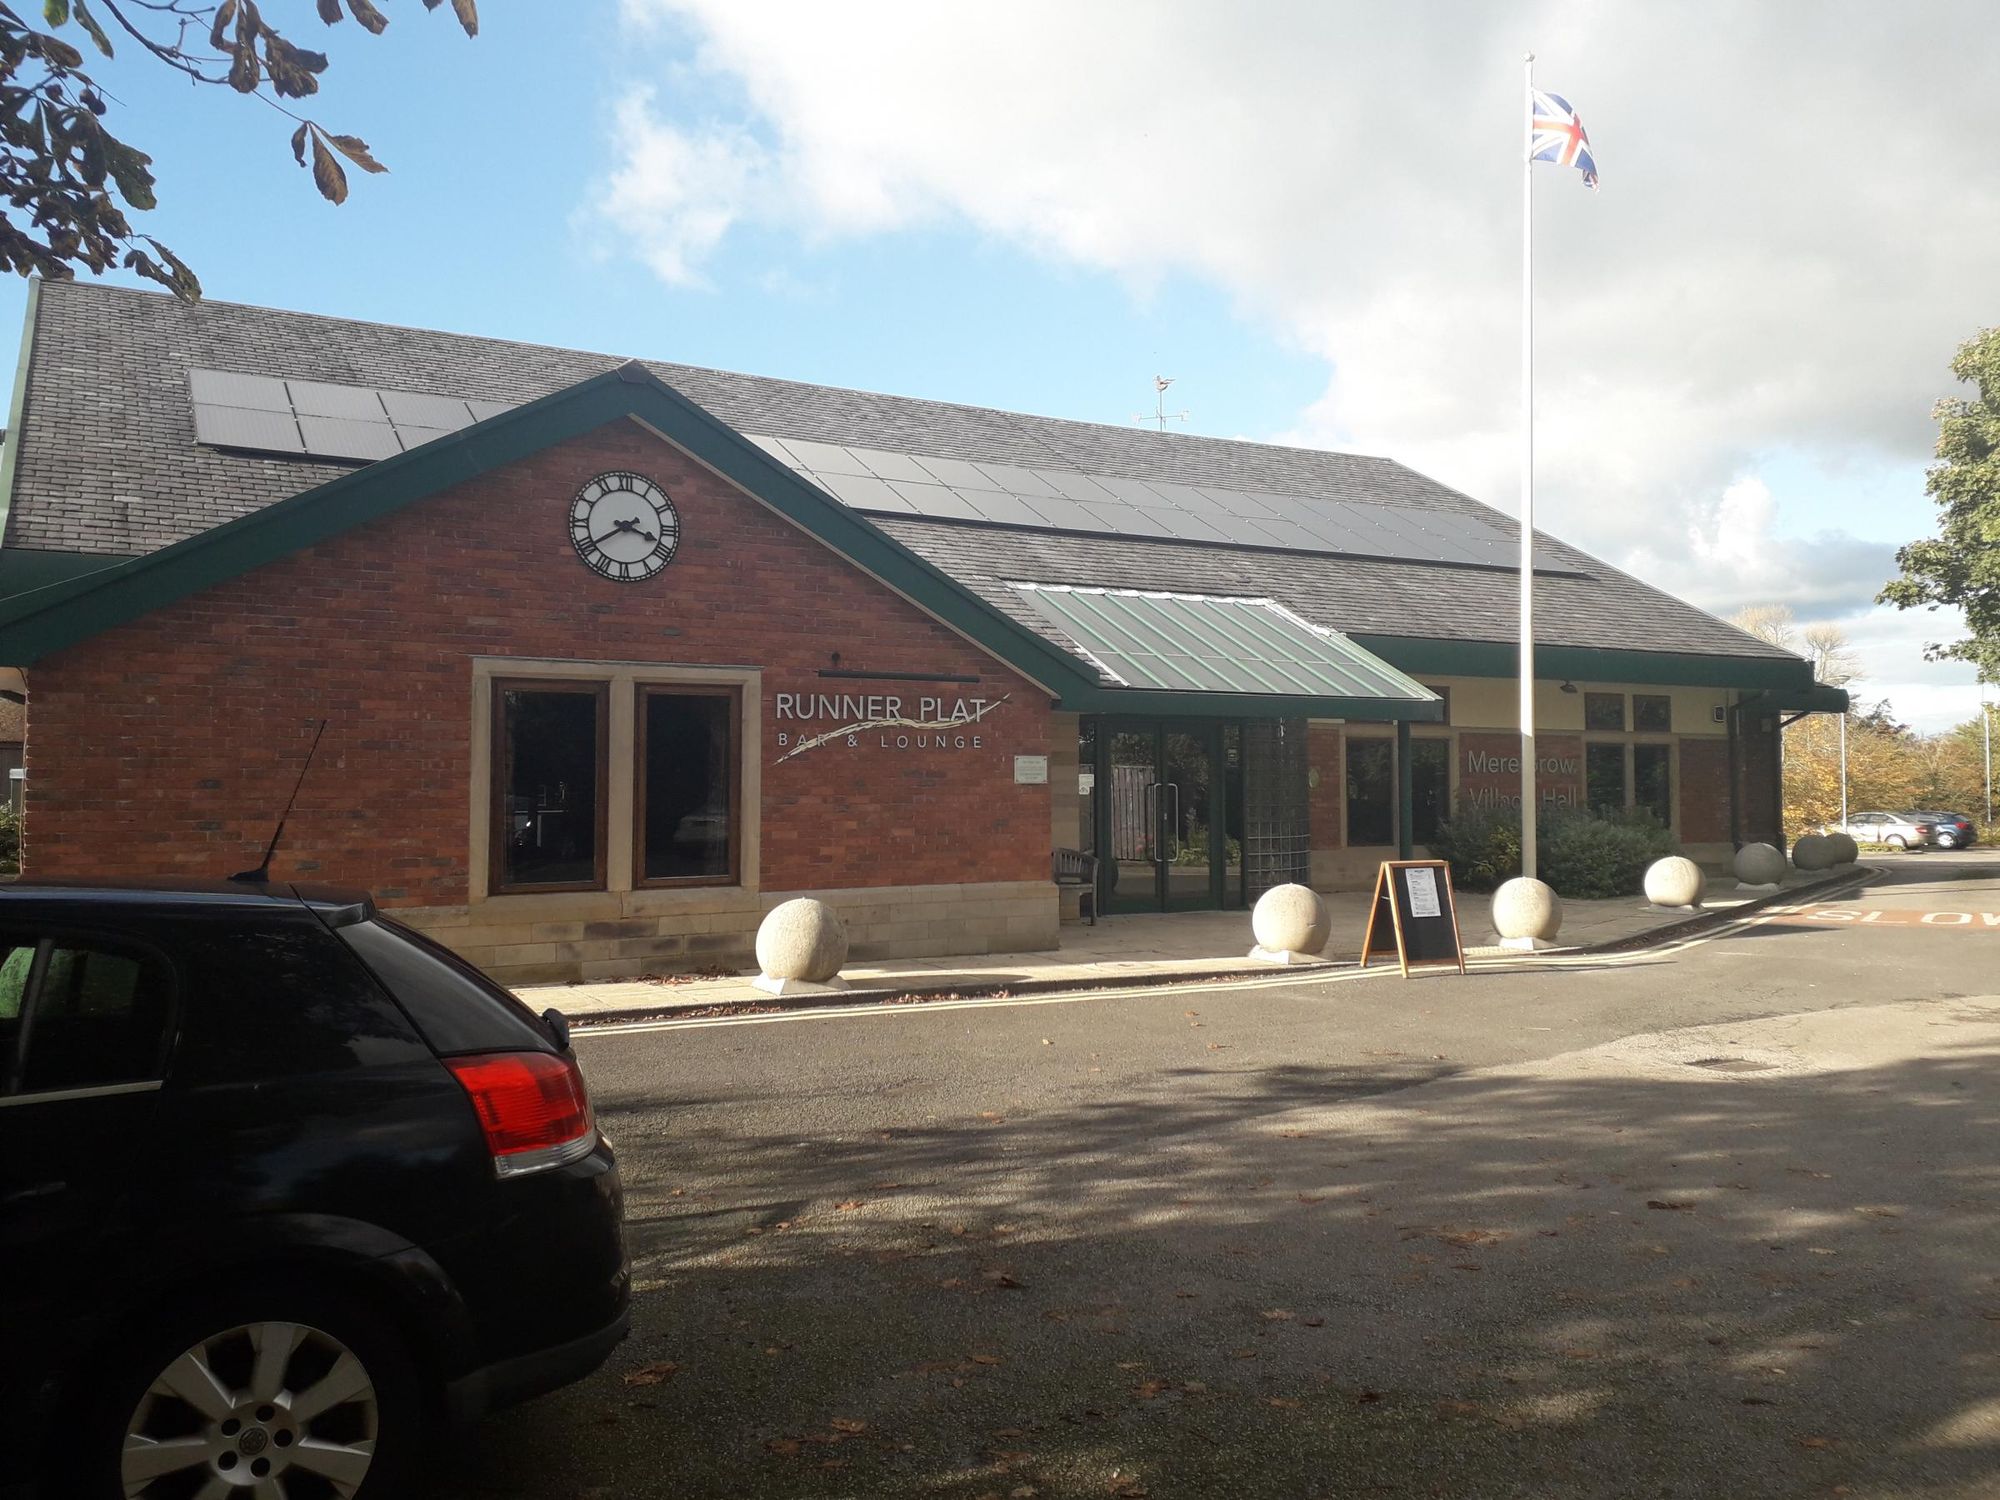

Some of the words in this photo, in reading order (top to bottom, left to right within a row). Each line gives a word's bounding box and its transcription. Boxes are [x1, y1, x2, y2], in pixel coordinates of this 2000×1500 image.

[775, 693, 901, 721] RUNNER
[920, 697, 987, 723] PLAT
[778, 733, 827, 747] BAR
[847, 734, 858, 747] &
[880, 735, 982, 748] LOUNGE
[1468, 749, 1520, 773] Mere
[1533, 753, 1574, 774] row
[1468, 785, 1523, 811] Villa
[1542, 785, 1577, 809] Hall
